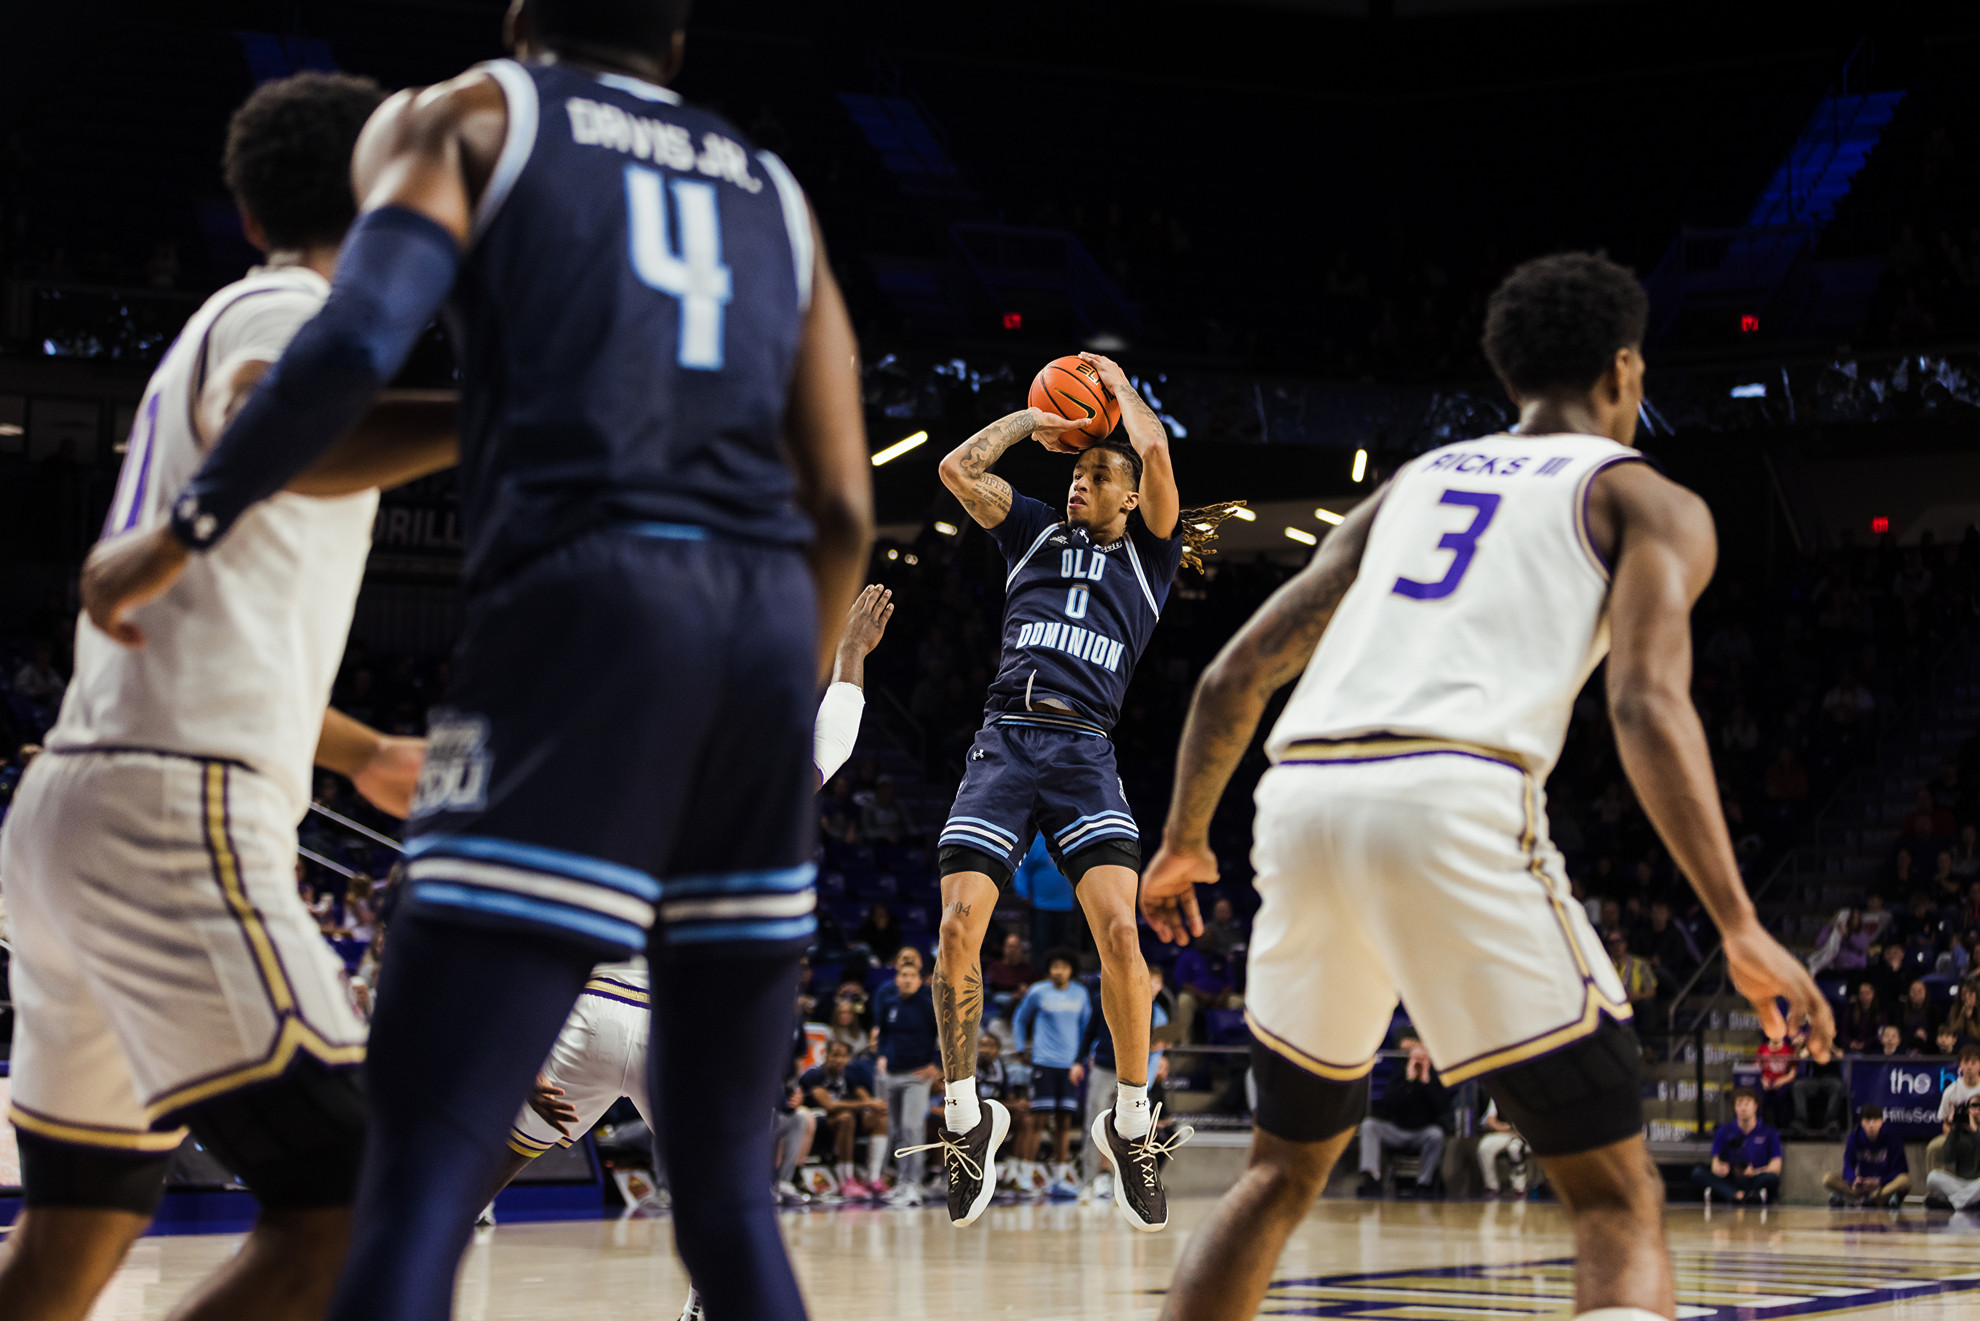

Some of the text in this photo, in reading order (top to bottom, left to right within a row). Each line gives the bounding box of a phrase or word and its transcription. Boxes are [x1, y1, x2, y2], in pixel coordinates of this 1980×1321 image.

[565, 97, 696, 171] DAVIS
[622, 162, 732, 371] 4
[1422, 453, 1532, 476] RICKS
[1060, 548, 1107, 582] OLD
[1391, 489, 1503, 601] 3
[1064, 582, 1090, 620] 0
[1015, 621, 1125, 673] DOMINION
[1890, 1067, 1932, 1095] the
